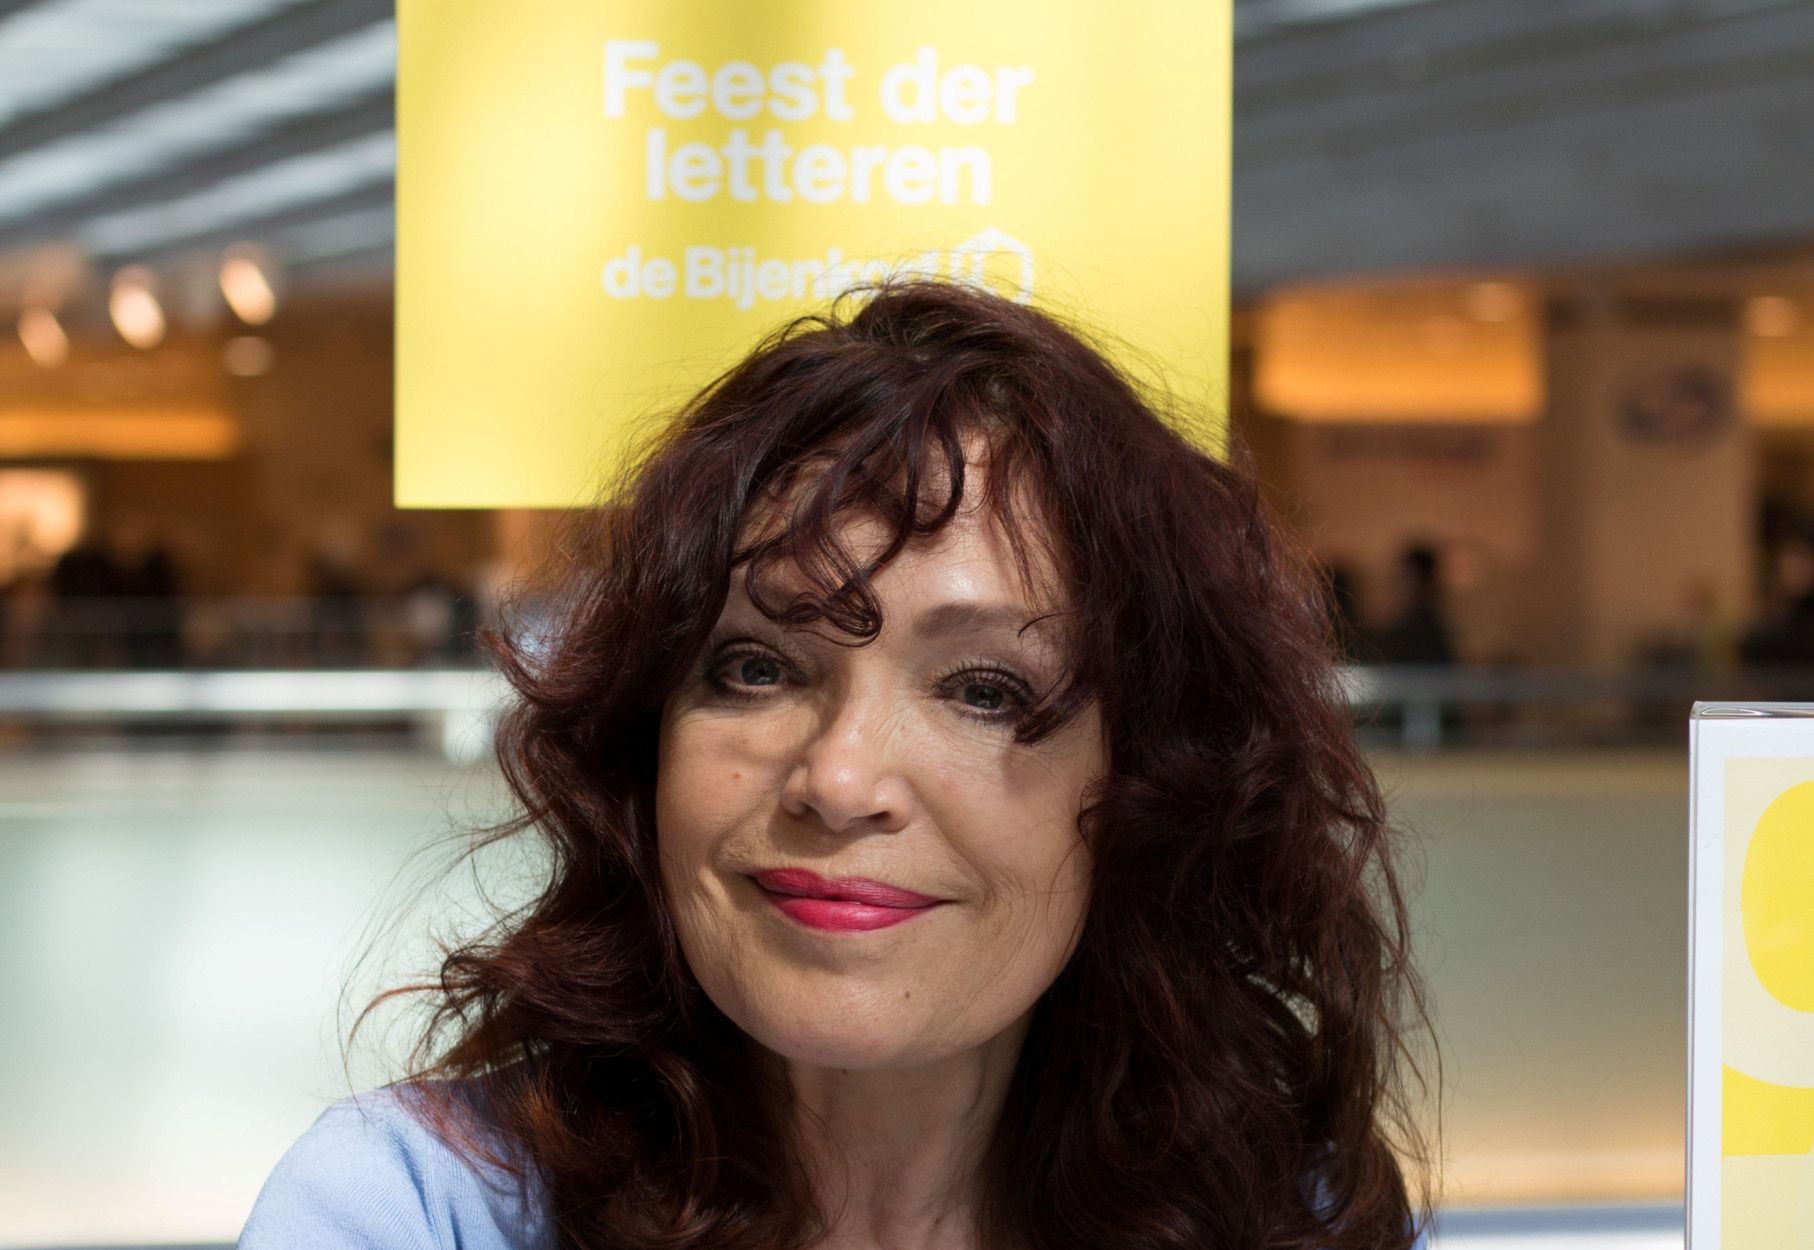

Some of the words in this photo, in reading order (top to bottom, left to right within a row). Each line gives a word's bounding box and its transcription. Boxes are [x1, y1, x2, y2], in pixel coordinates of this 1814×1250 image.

[603, 39, 854, 120] Feest
[880, 46, 1035, 124] der
[645, 128, 992, 205] letteren
[603, 246, 676, 299] de
